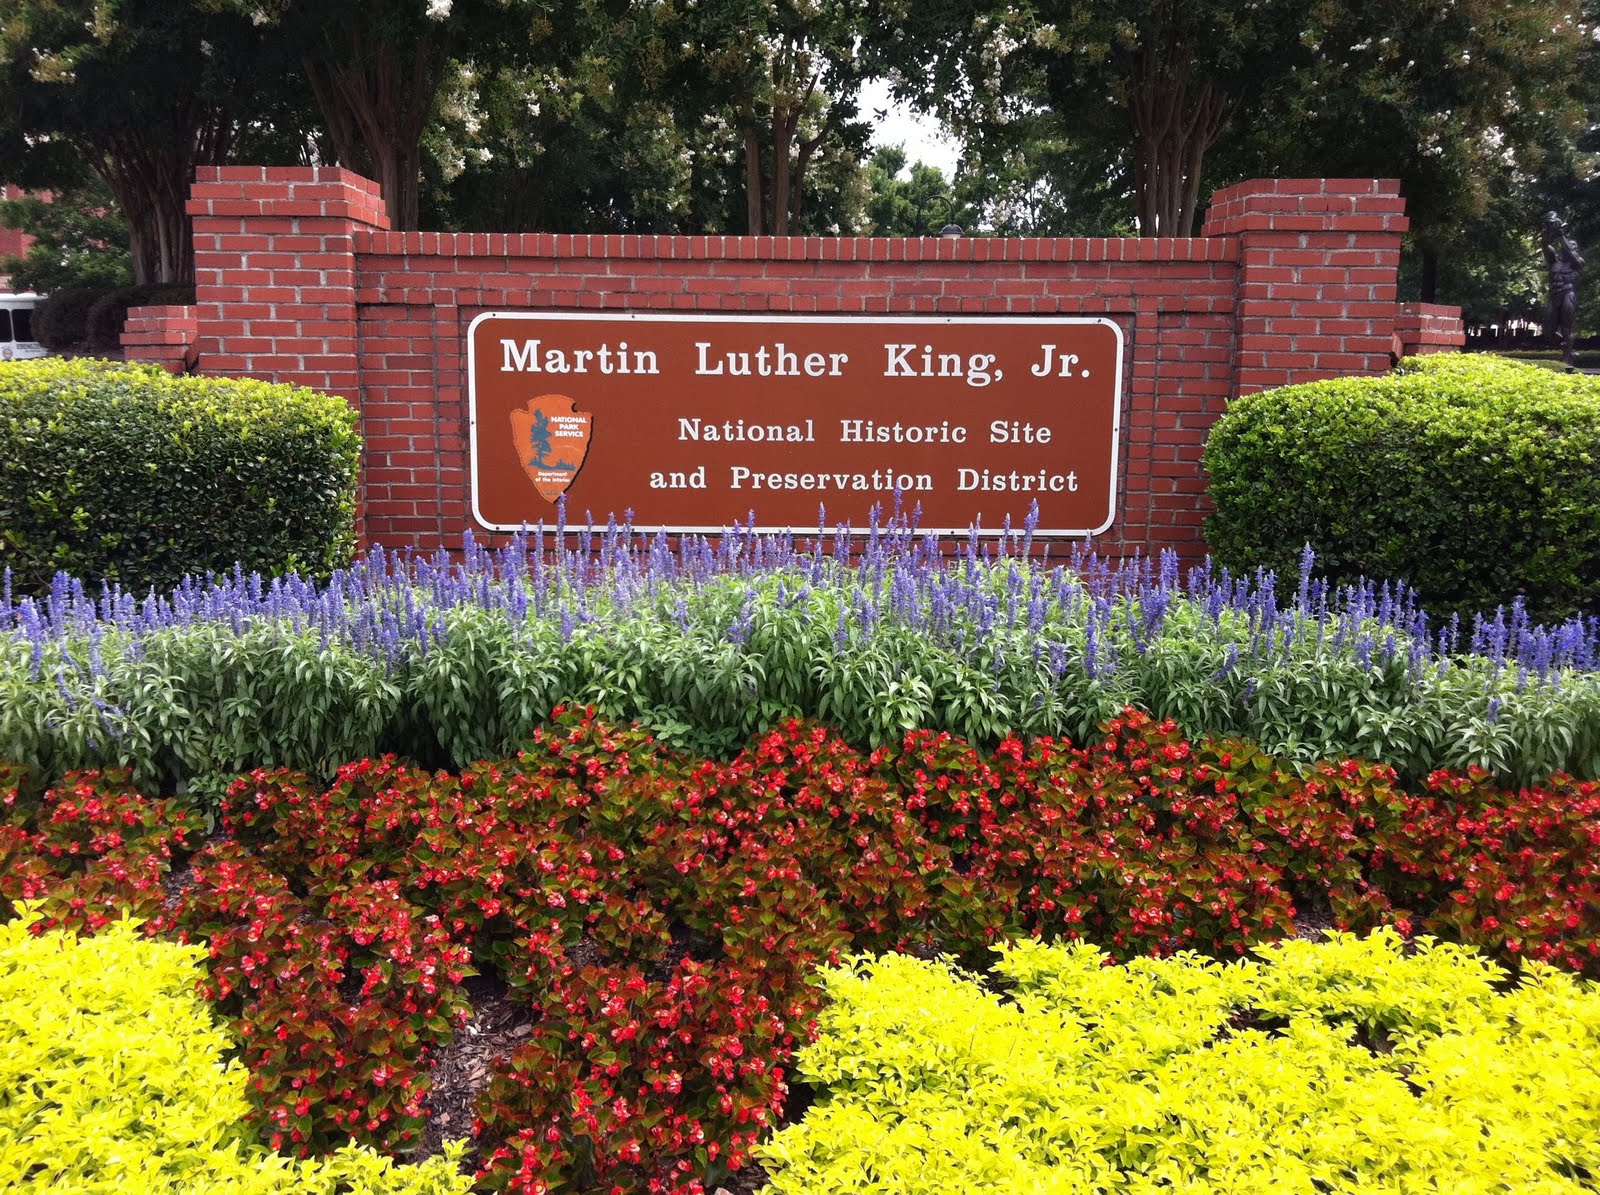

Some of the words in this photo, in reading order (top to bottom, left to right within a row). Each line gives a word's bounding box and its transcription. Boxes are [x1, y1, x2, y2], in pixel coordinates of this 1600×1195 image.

[500, 338, 660, 375] Martin
[694, 342, 849, 377] Luther
[883, 343, 1004, 387] King,
[1030, 344, 1090, 378] Jr.
[677, 418, 815, 442] National
[840, 419, 967, 444] Historic
[990, 420, 1052, 444] Site
[649, 466, 707, 489] and
[730, 466, 934, 491] Preservation
[956, 468, 1078, 493] District
